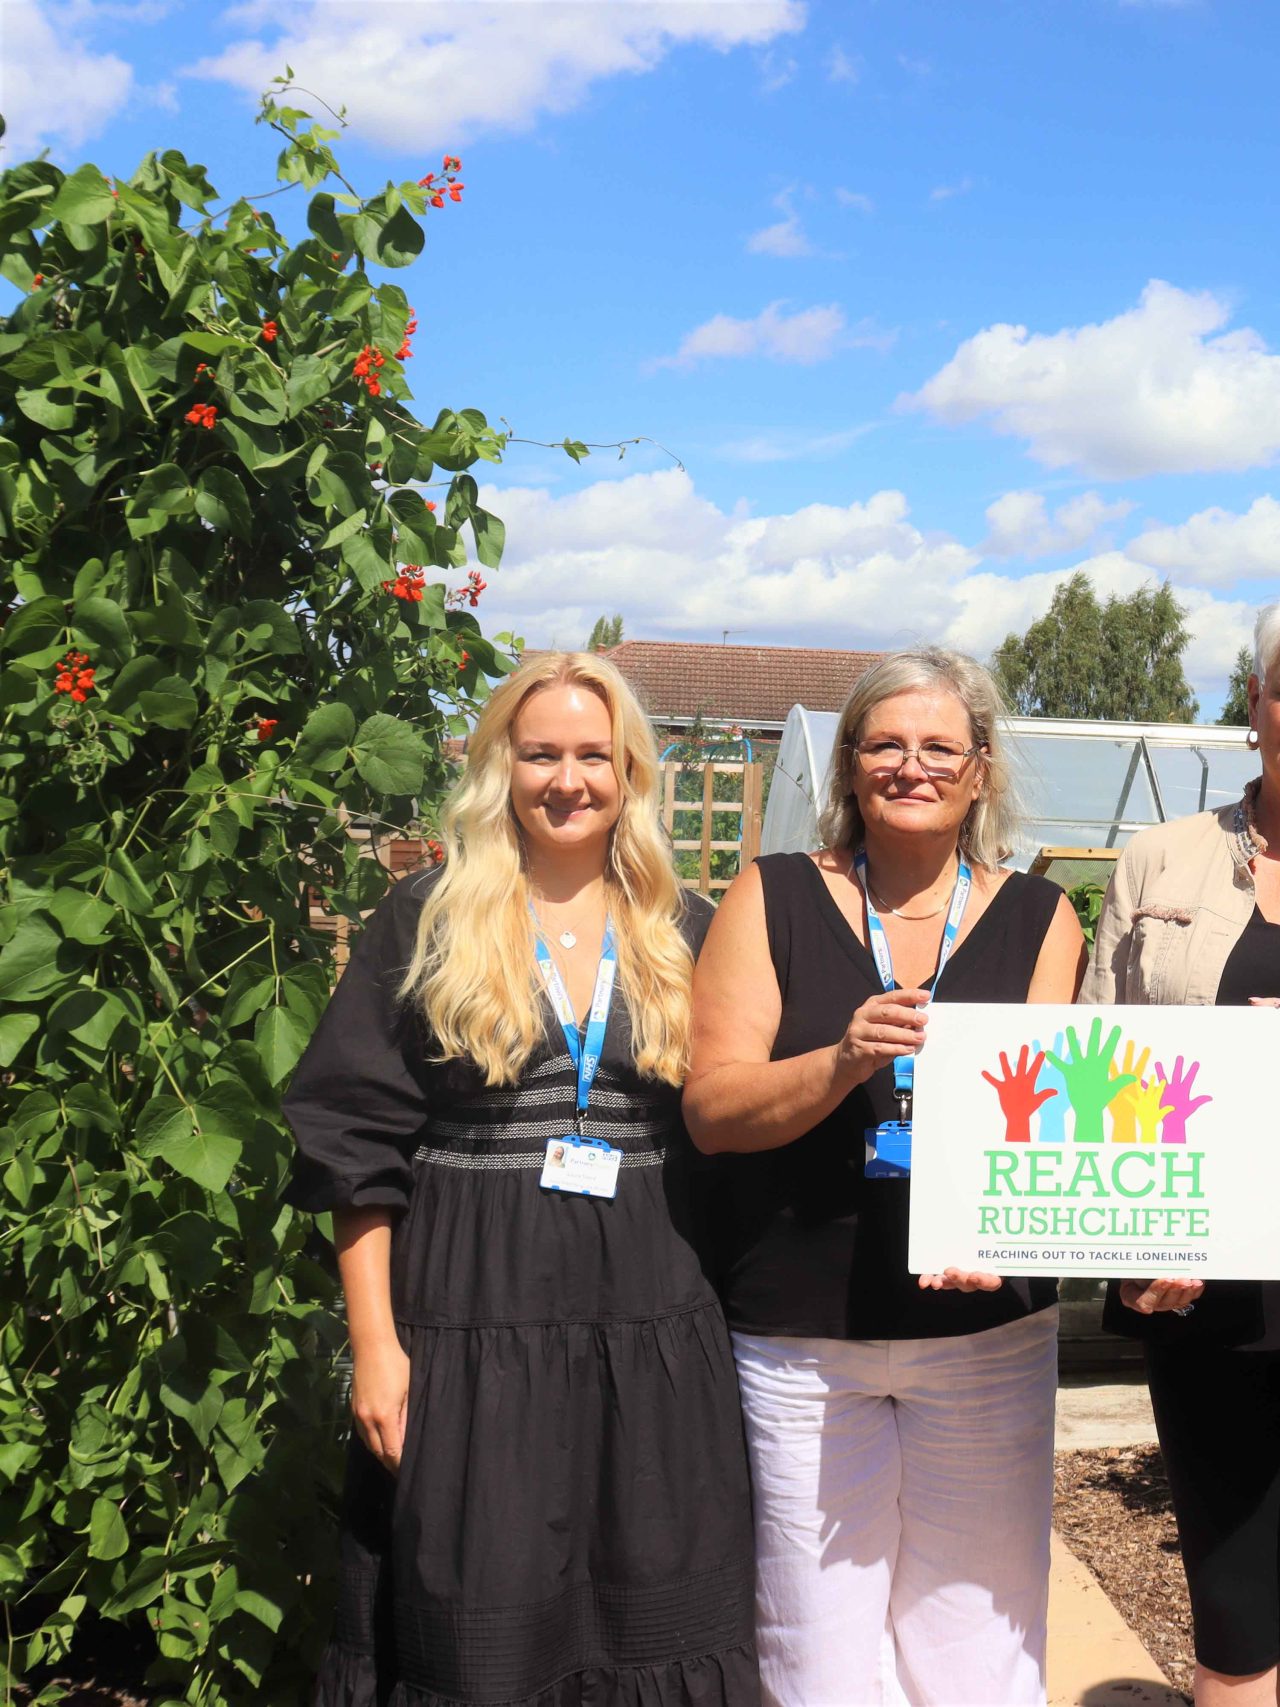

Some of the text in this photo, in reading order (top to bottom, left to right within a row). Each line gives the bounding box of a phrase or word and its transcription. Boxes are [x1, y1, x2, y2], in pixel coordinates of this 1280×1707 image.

[584, 1055, 596, 1081] NHS
[983, 1150, 1205, 1198] REACH
[978, 1206, 1209, 1237] RUSHCLIFFE
[978, 1249, 1208, 1262] REACHING OUT TO TACKLE LONELINESS
